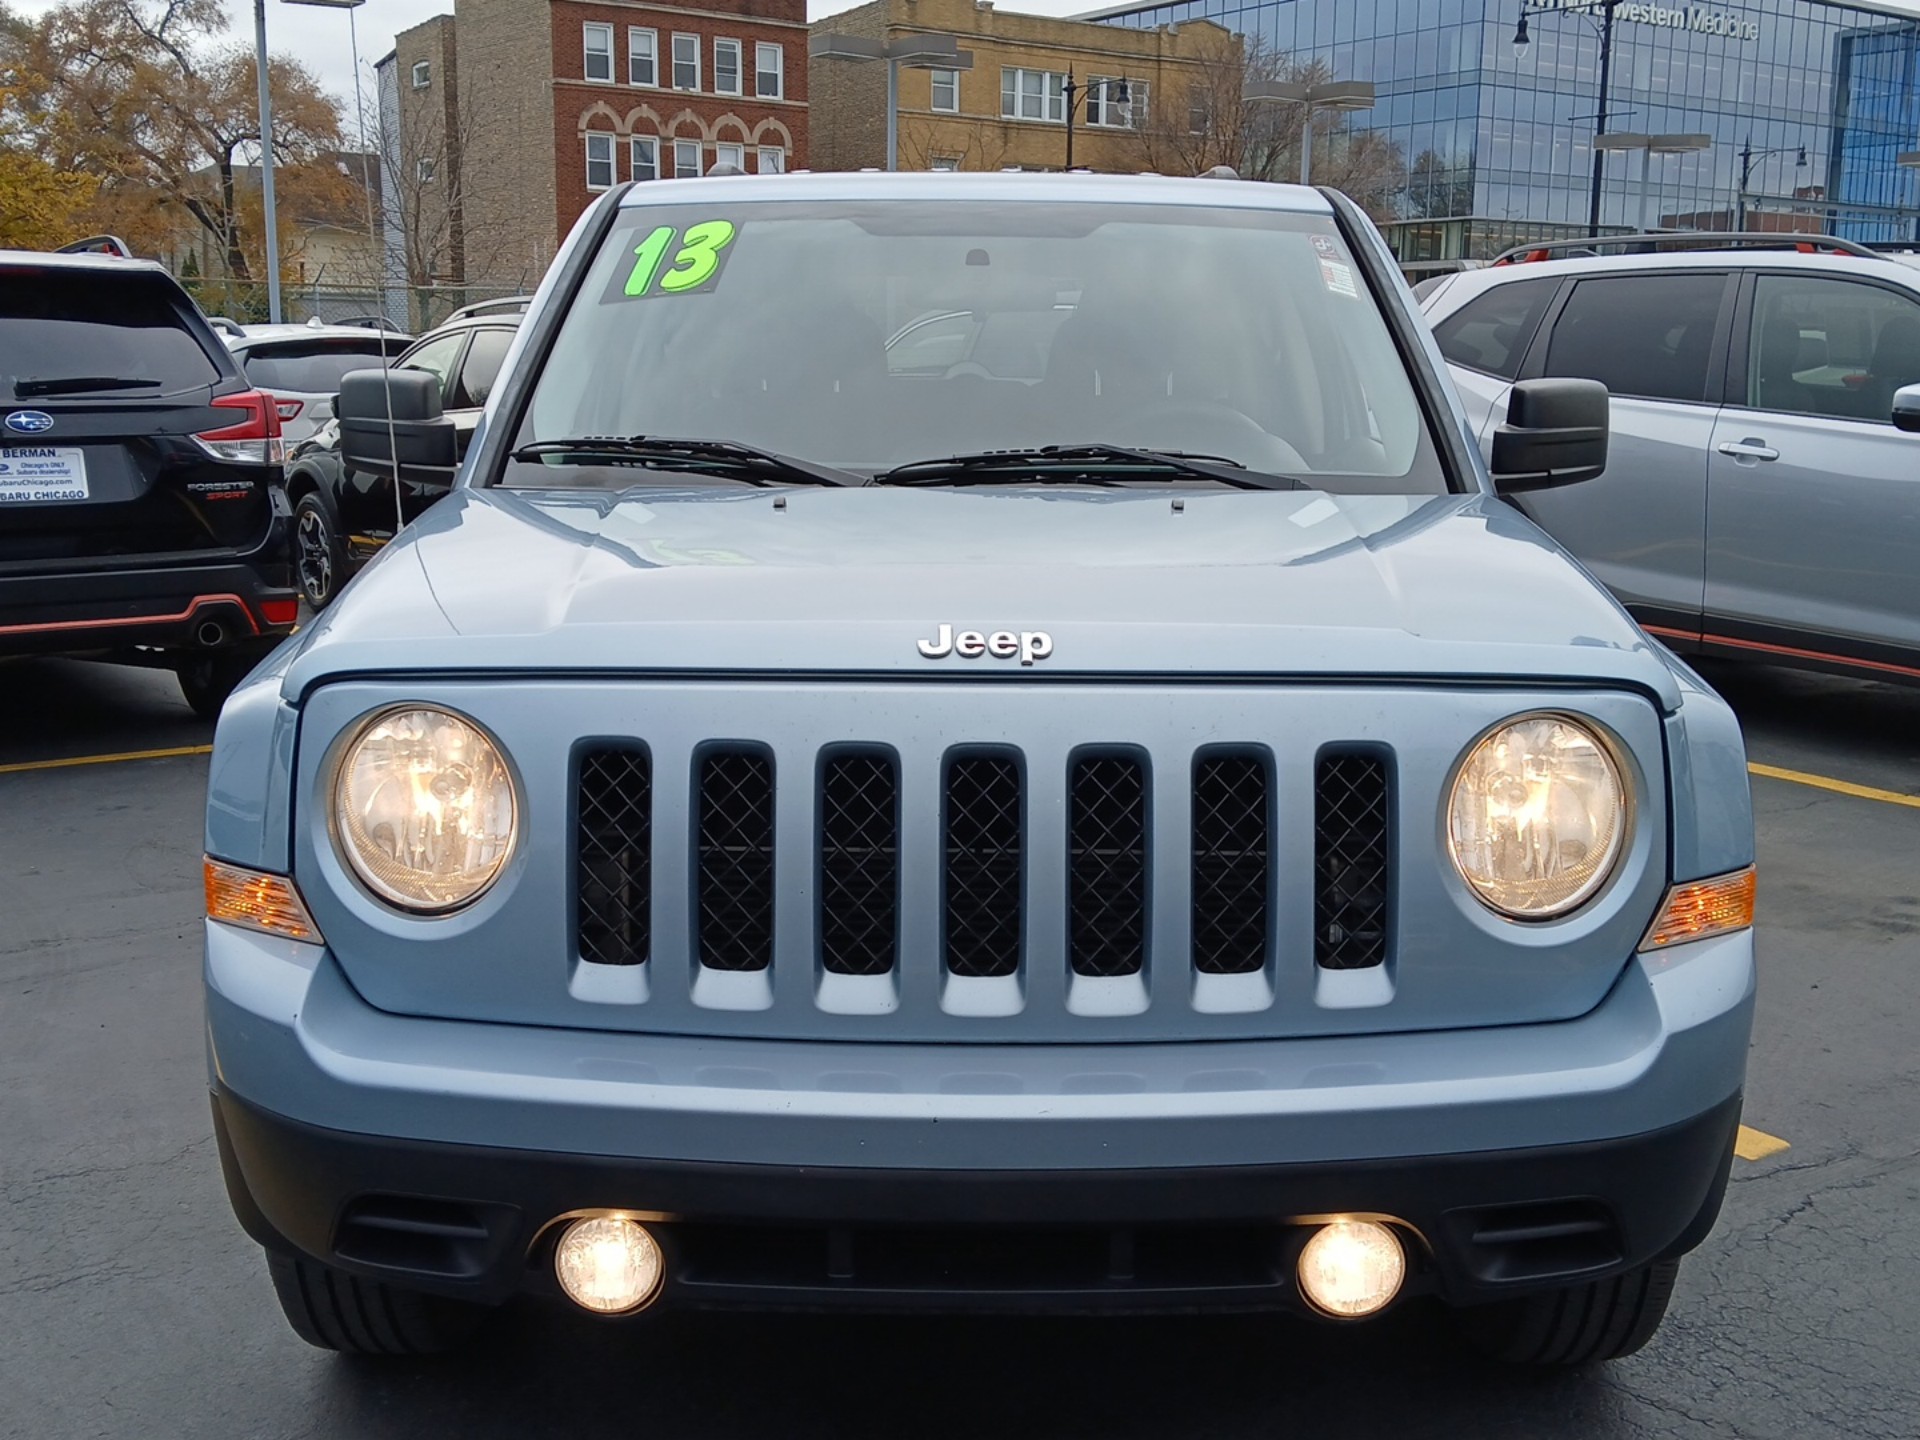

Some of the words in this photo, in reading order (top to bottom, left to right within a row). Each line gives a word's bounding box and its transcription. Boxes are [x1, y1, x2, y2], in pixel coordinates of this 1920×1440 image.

[1687, 6, 1758, 40] Medicine
[624, 219, 736, 297] 13
[2, 448, 56, 458] BERMAN
[187, 481, 254, 491] FORESTER
[34, 490, 85, 499] CHICAGO
[206, 490, 248, 500] SPORT
[916, 624, 1054, 667] Jeep
